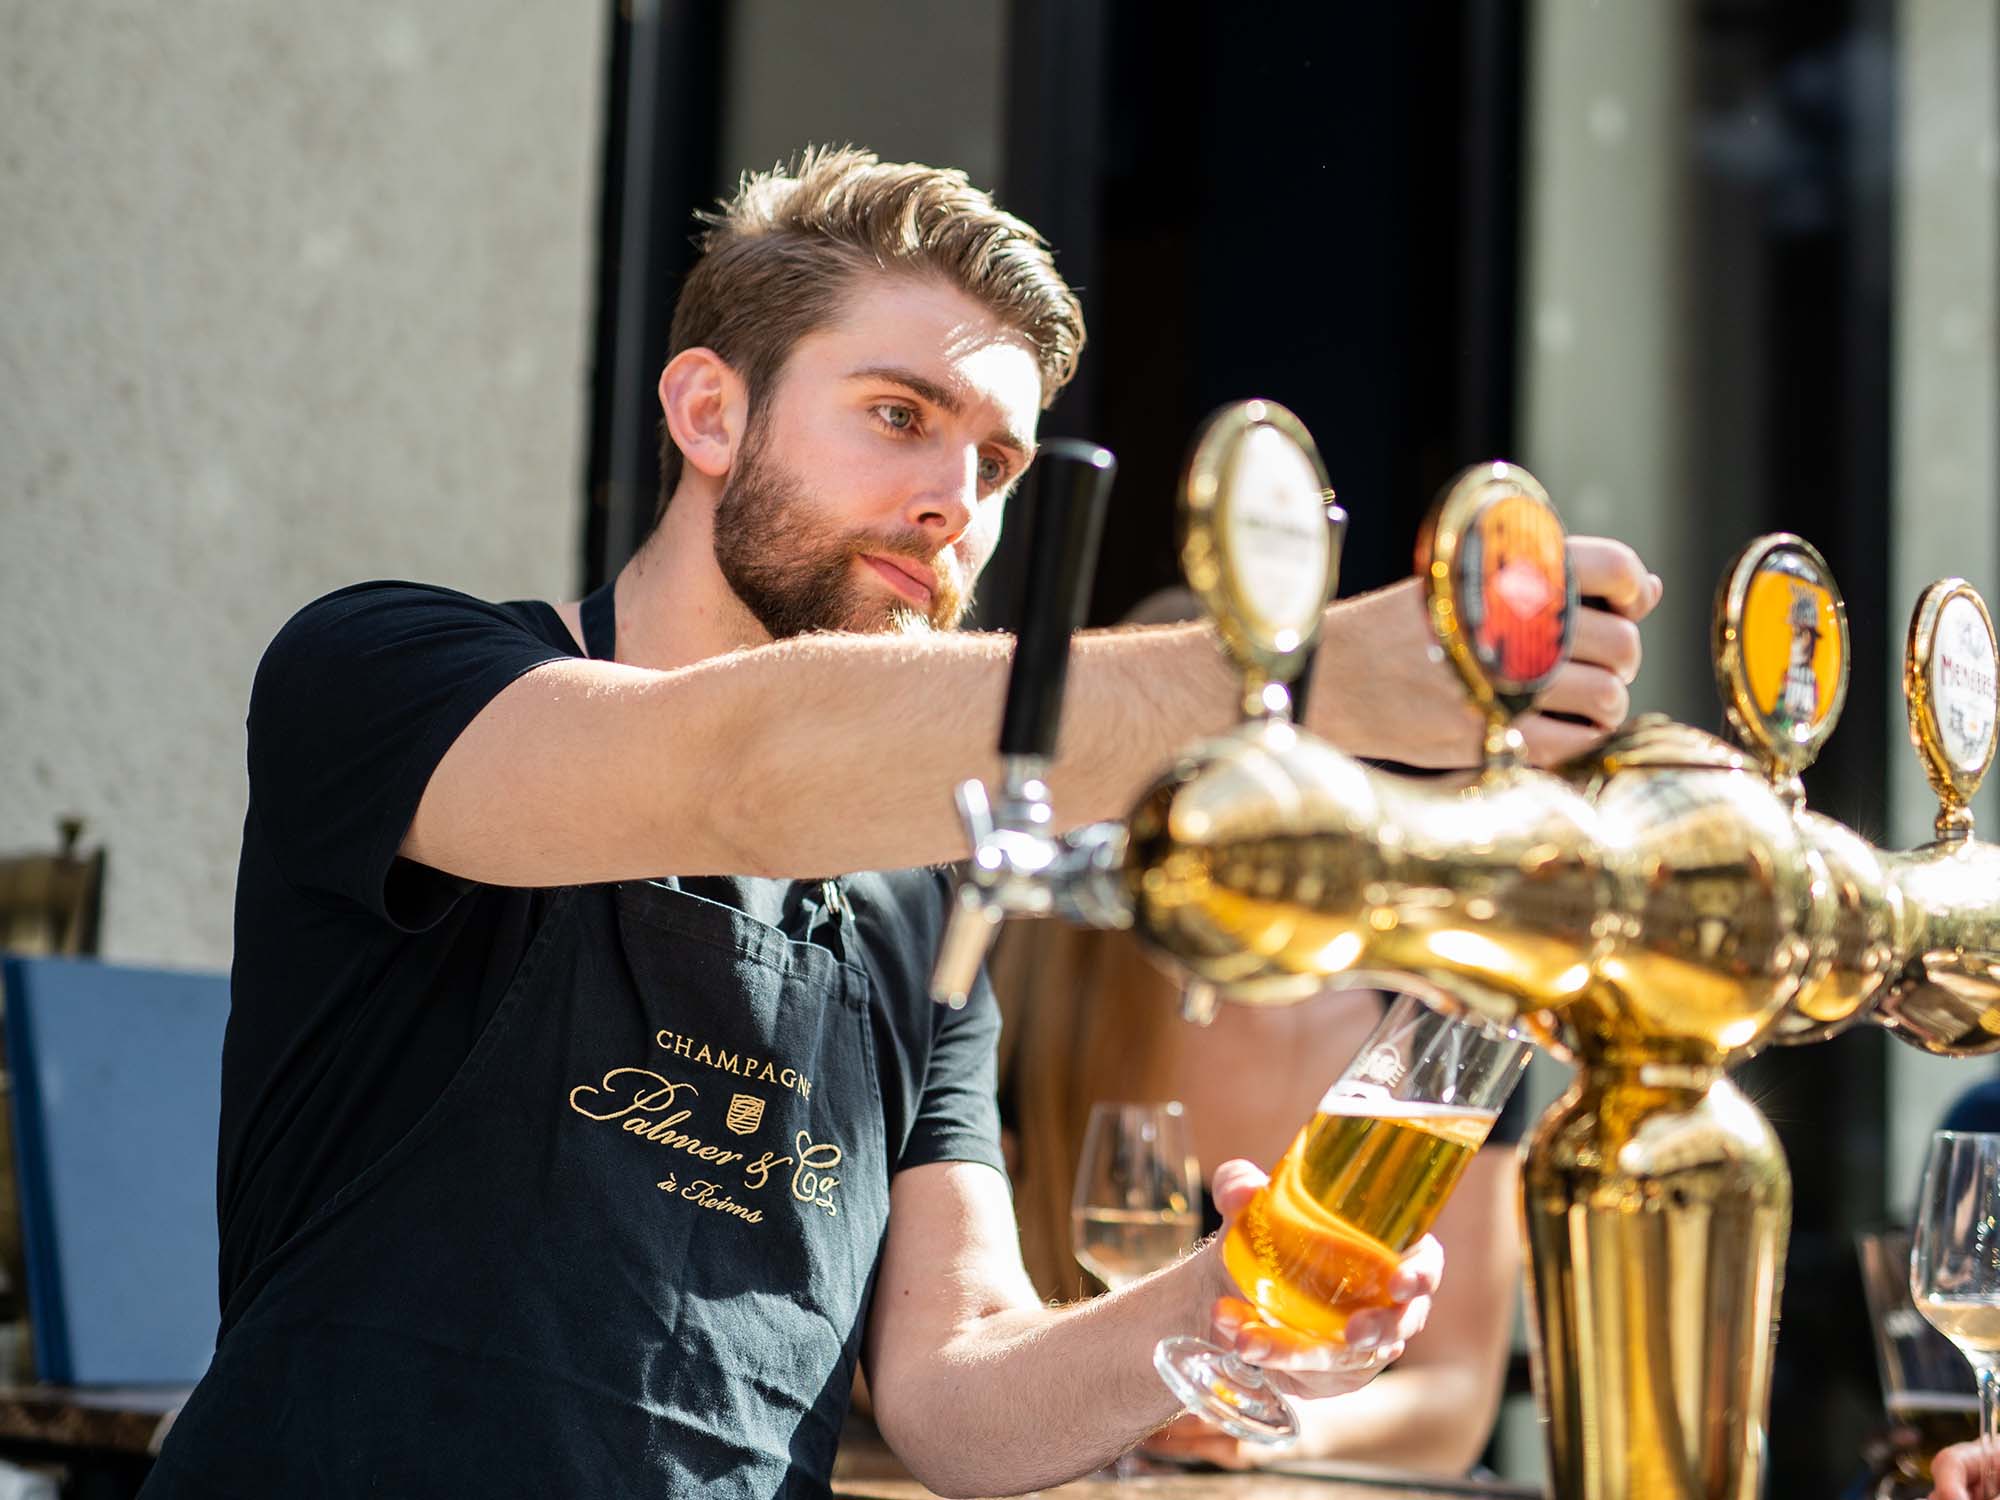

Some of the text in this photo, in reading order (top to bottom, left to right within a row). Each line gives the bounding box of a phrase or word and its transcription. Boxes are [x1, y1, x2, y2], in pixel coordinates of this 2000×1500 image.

[569, 1067, 743, 1166] Palmer
[744, 1151, 793, 1189] &
[656, 1172, 764, 1224] à Reims
